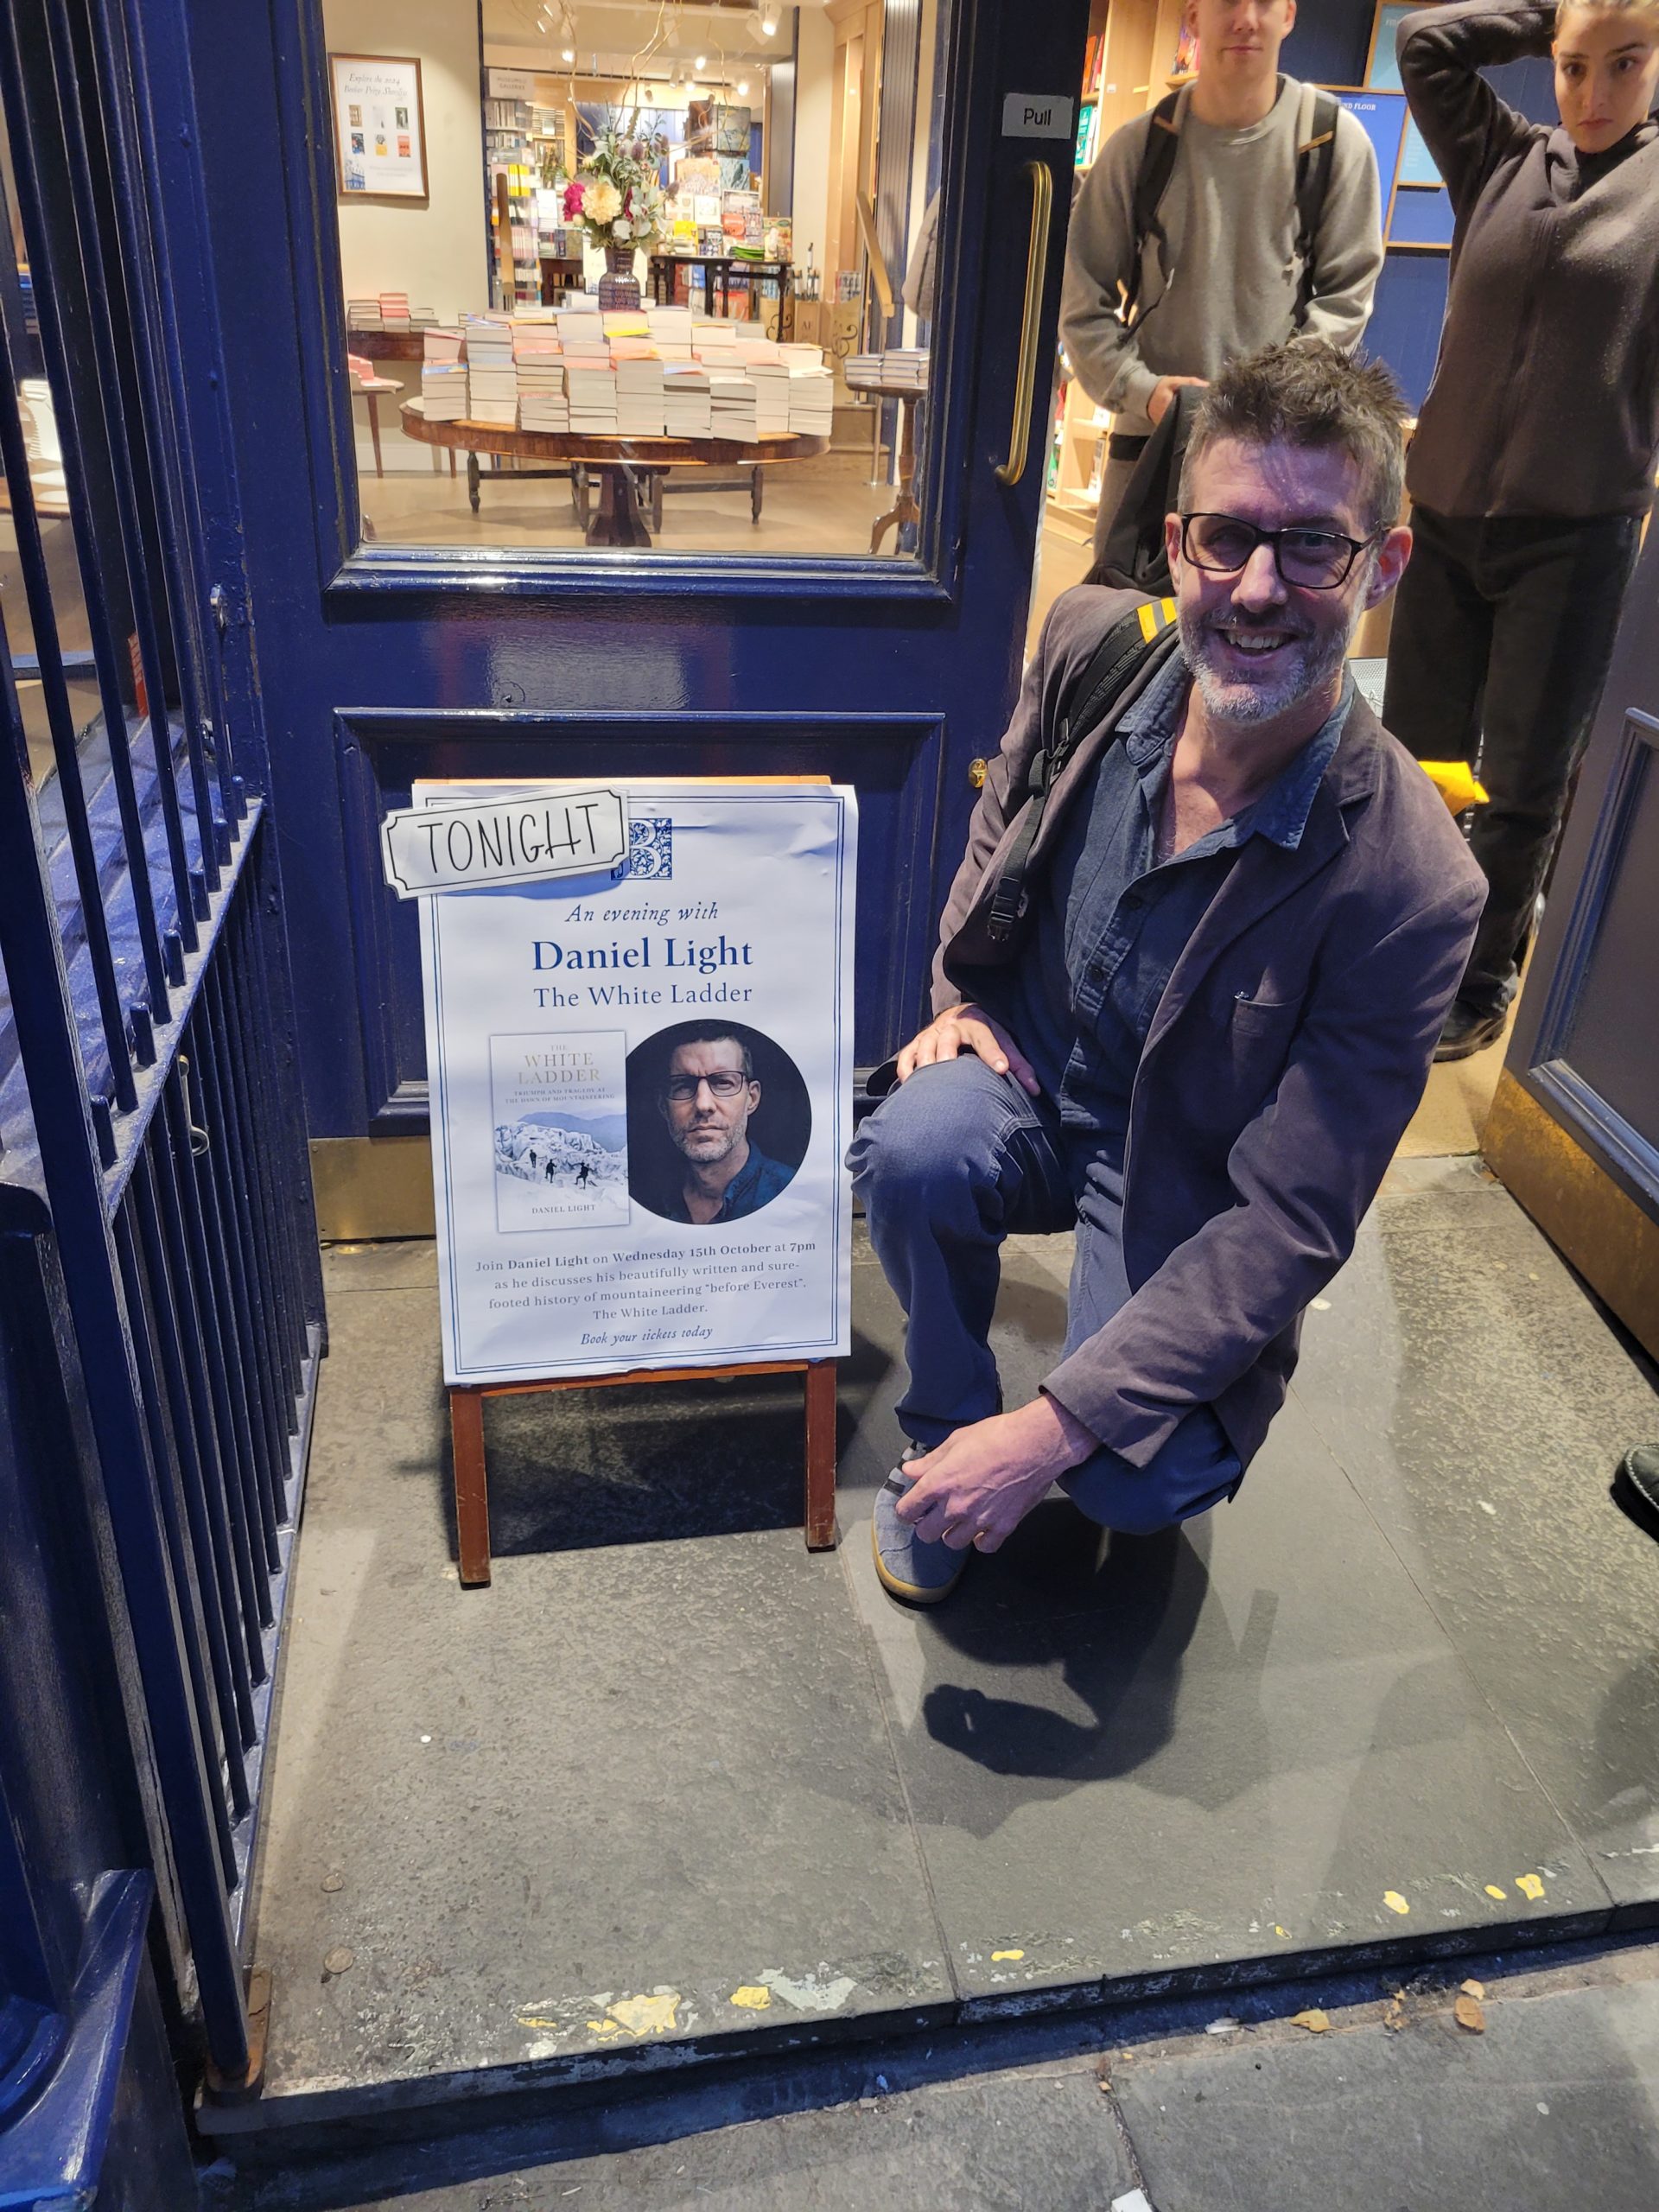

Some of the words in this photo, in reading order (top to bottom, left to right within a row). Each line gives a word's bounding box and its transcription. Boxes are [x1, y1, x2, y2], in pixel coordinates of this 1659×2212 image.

[1023, 107, 1052, 126] Pull
[1354, 103, 1376, 111] FLOOR
[416, 803, 600, 874] TONIGHT
[564, 903, 595, 923] An
[602, 901, 671, 926] evening
[677, 901, 719, 921] with
[531, 937, 651, 970] Daniel
[664, 935, 754, 975] Light
[533, 986, 580, 1007] The
[588, 984, 662, 1007] White
[671, 982, 753, 1004] Ladder
[524, 1052, 594, 1068] WHITE
[518, 1068, 601, 1085] LADDER
[568, 1204, 595, 1212] LIGHT
[475, 1260, 504, 1272] Join
[507, 1257, 551, 1270] Daniel
[555, 1255, 589, 1268] Light
[592, 1255, 608, 1265] on
[612, 1249, 685, 1262] Wednesday
[690, 1246, 716, 1258] 15th
[720, 1243, 772, 1255] October
[774, 1243, 786, 1253] at
[789, 1243, 817, 1254] 7pm
[494, 1281, 508, 1290] as
[512, 1278, 528, 1288] he
[531, 1275, 593, 1287] discusses
[596, 1272, 615, 1283] his
[619, 1267, 689, 1281] beautifully
[692, 1264, 738, 1275] written
[741, 1262, 765, 1273] and
[767, 1262, 800, 1272] sure-
[488, 1296, 531, 1309] footed
[534, 1294, 581, 1307] history
[583, 1292, 598, 1303] of
[600, 1284, 702, 1300] mountaineering
[592, 1309, 618, 1320] The
[620, 1306, 658, 1319] White
[661, 1302, 709, 1316] Ladder.
[580, 1332, 607, 1345] Book
[610, 1333, 638, 1347] your
[641, 1328, 677, 1343] tickets
[681, 1325, 714, 1340] today
